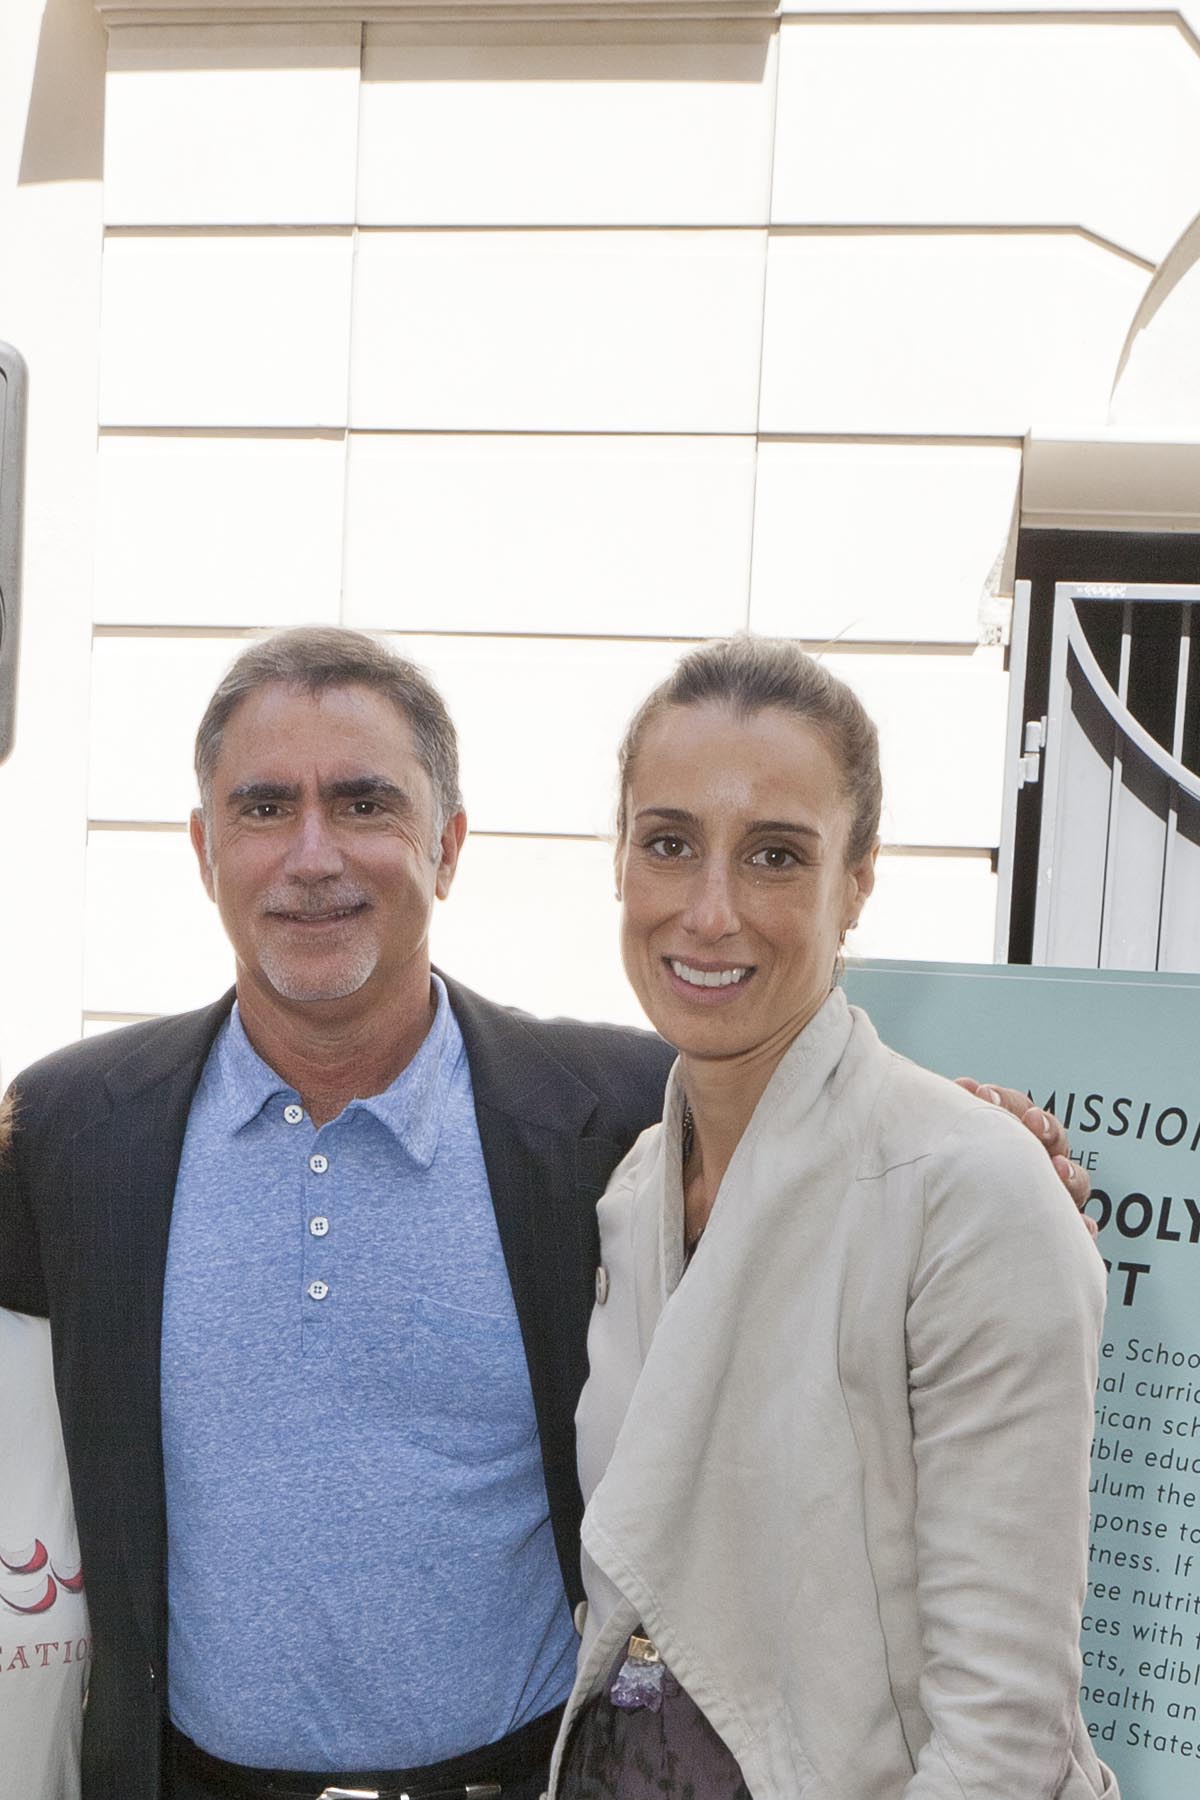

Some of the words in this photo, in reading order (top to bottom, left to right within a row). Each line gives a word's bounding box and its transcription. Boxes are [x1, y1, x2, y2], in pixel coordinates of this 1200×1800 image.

[1026, 1088, 1200, 1151] ISSIO
[1125, 1338, 1200, 1369] Schoo
[1096, 1372, 1126, 1394] al
[1094, 1404, 1152, 1432] ican
[1156, 1482, 1196, 1508] the
[1090, 1513, 1168, 1539] ponse
[1174, 1553, 1195, 1577] If
[1087, 1581, 1121, 1601] ee
[1132, 1621, 1184, 1648] with
[1138, 1657, 1200, 1686] edibl
[1167, 1702, 1197, 1721] an
